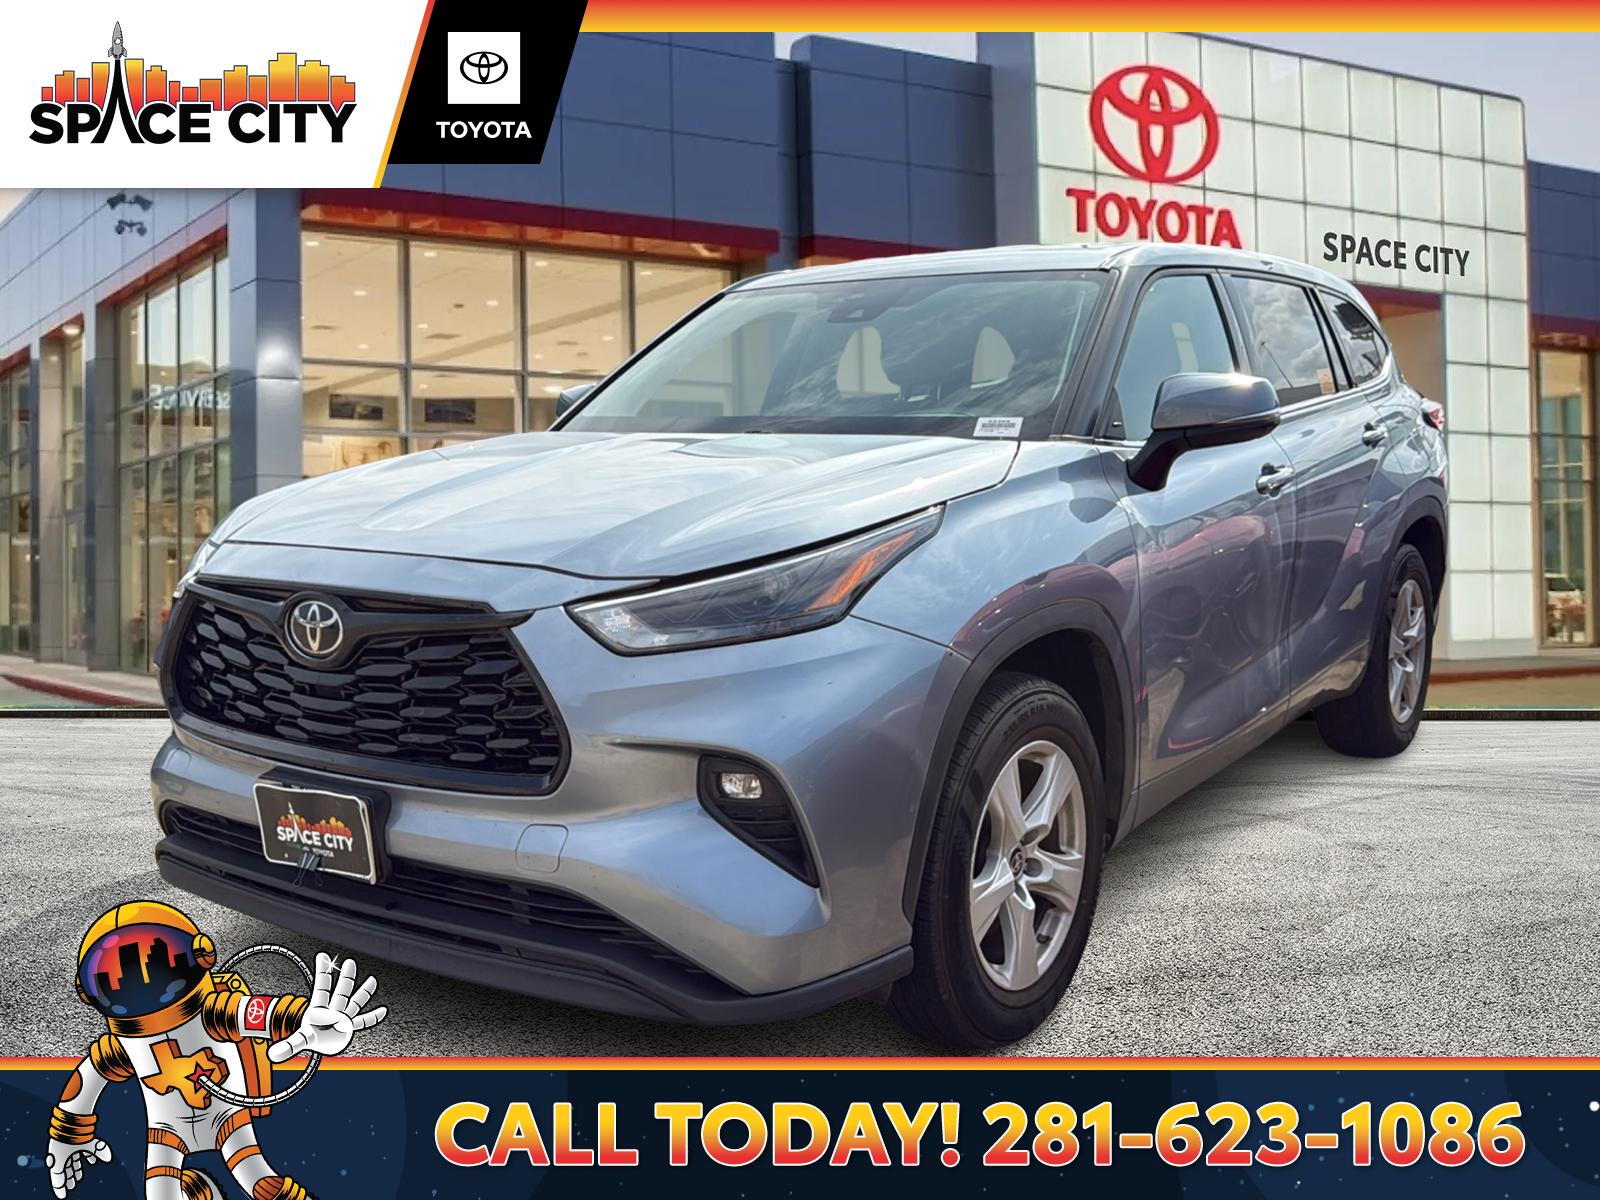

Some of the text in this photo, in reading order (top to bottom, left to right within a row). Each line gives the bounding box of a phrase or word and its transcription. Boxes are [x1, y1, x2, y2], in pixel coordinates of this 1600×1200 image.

[1066, 187, 1242, 249] TOYOTA
[1323, 232, 1470, 277] SPACE CITY
[276, 813, 353, 852] SPACE CITY
